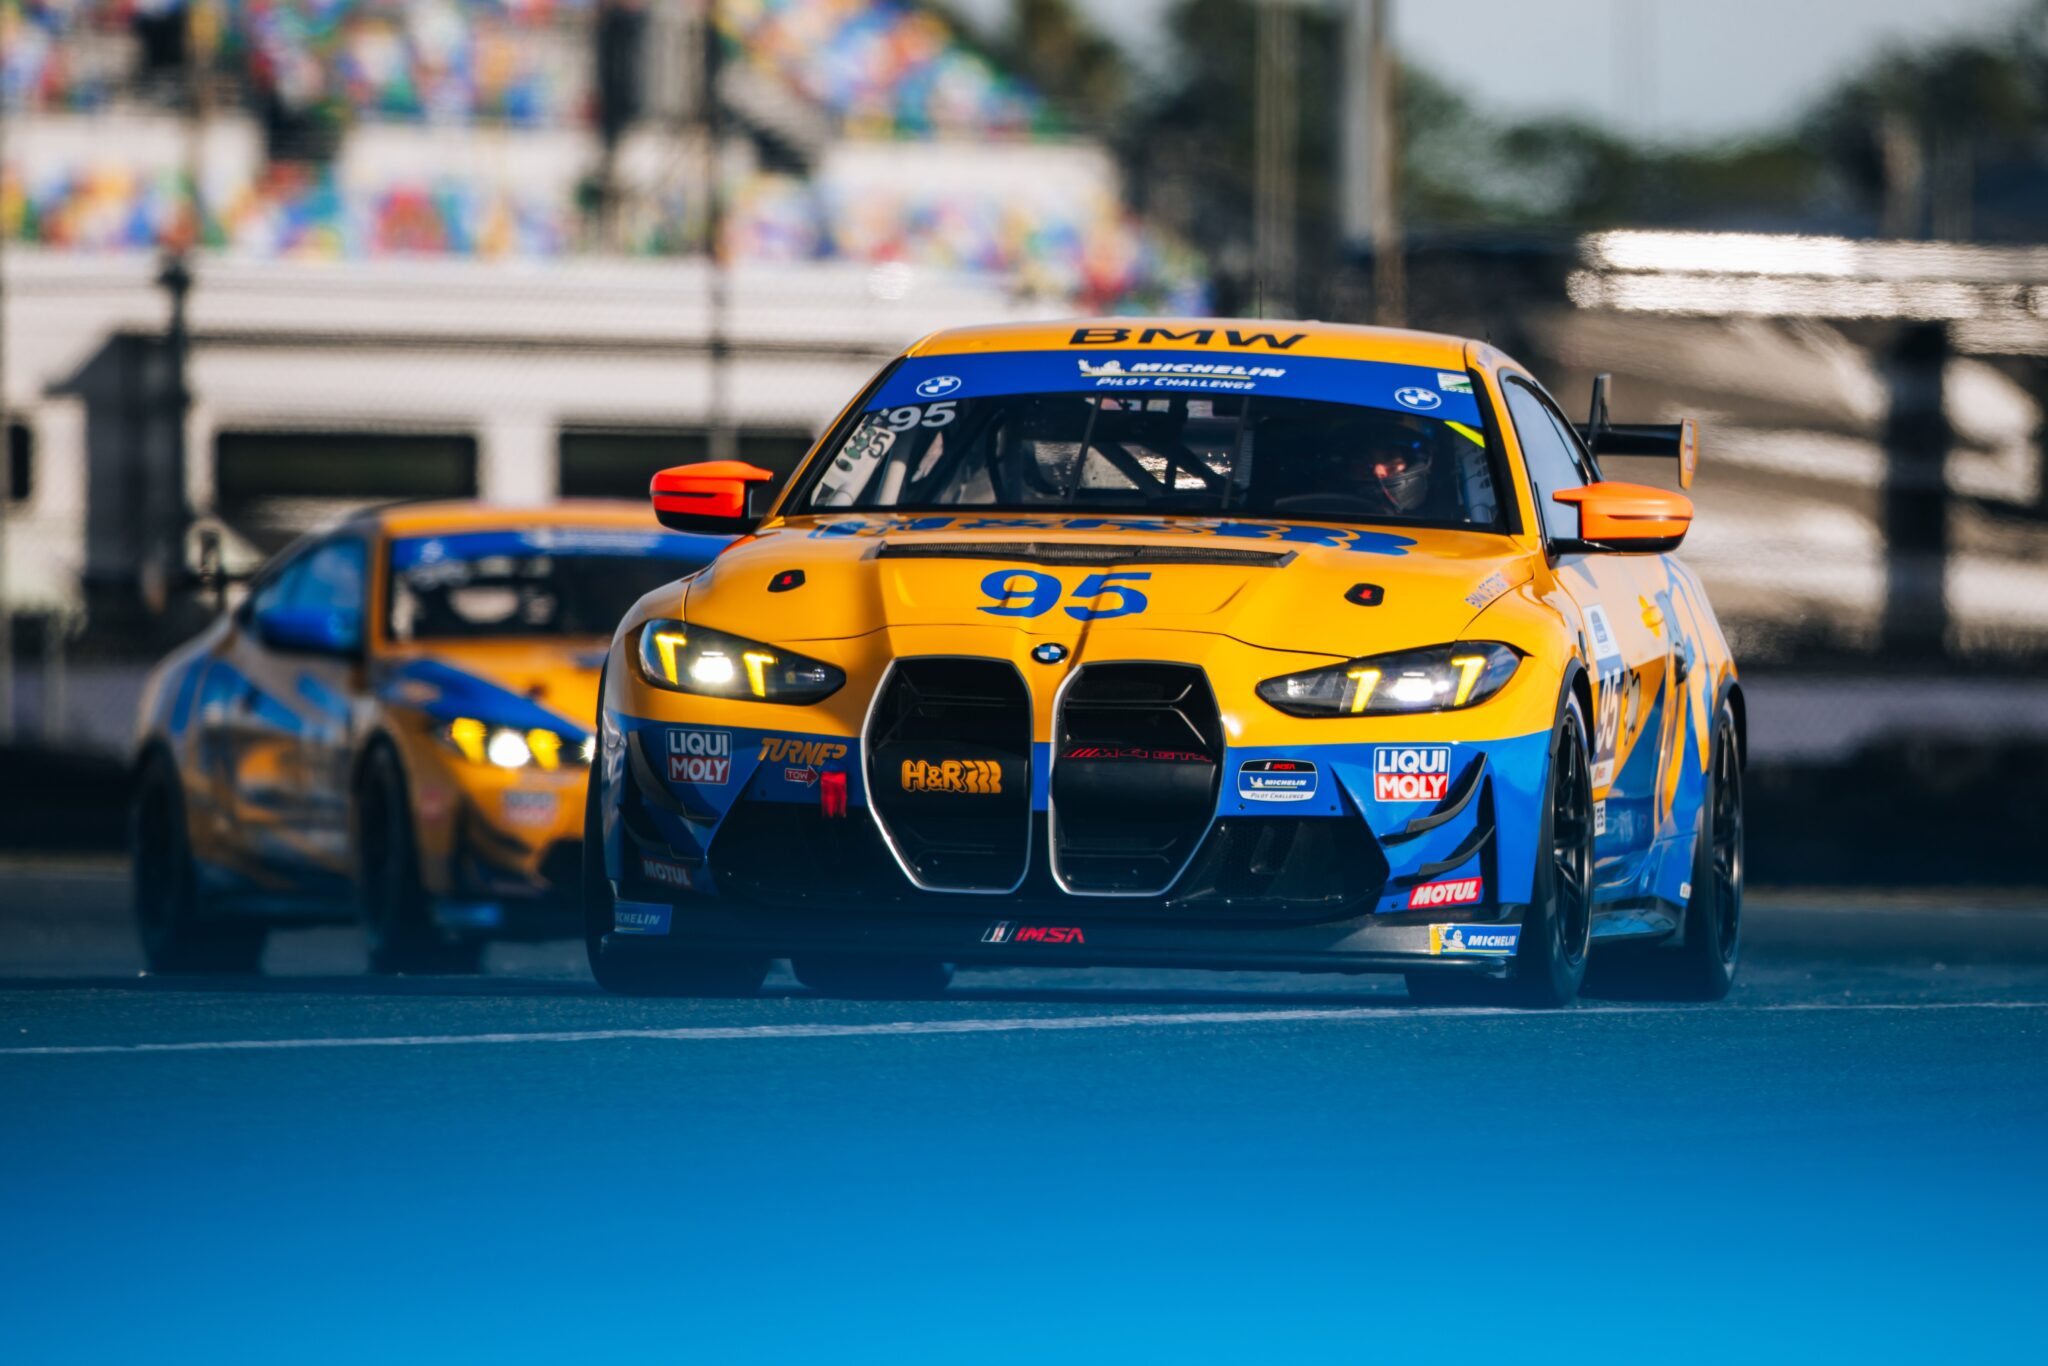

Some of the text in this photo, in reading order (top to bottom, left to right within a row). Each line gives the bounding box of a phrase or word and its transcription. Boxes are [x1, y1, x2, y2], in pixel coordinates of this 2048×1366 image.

[1068, 328, 1308, 350] BMW
[1130, 362, 1286, 378] MICHELIN
[1097, 377, 1256, 390] PILOT CHALLENGE
[887, 401, 957, 433] 95
[977, 570, 1152, 621] 95
[669, 731, 729, 757] LIQUI
[671, 755, 729, 782] MOLY
[1378, 750, 1447, 774] LIQUI
[787, 770, 808, 781] TOW
[1378, 775, 1448, 799] MOLY
[643, 859, 690, 886] MOTUL
[1411, 880, 1477, 906] MOTUL
[1015, 927, 1084, 944] IMSA
[1467, 935, 1517, 947] MICHELIN
